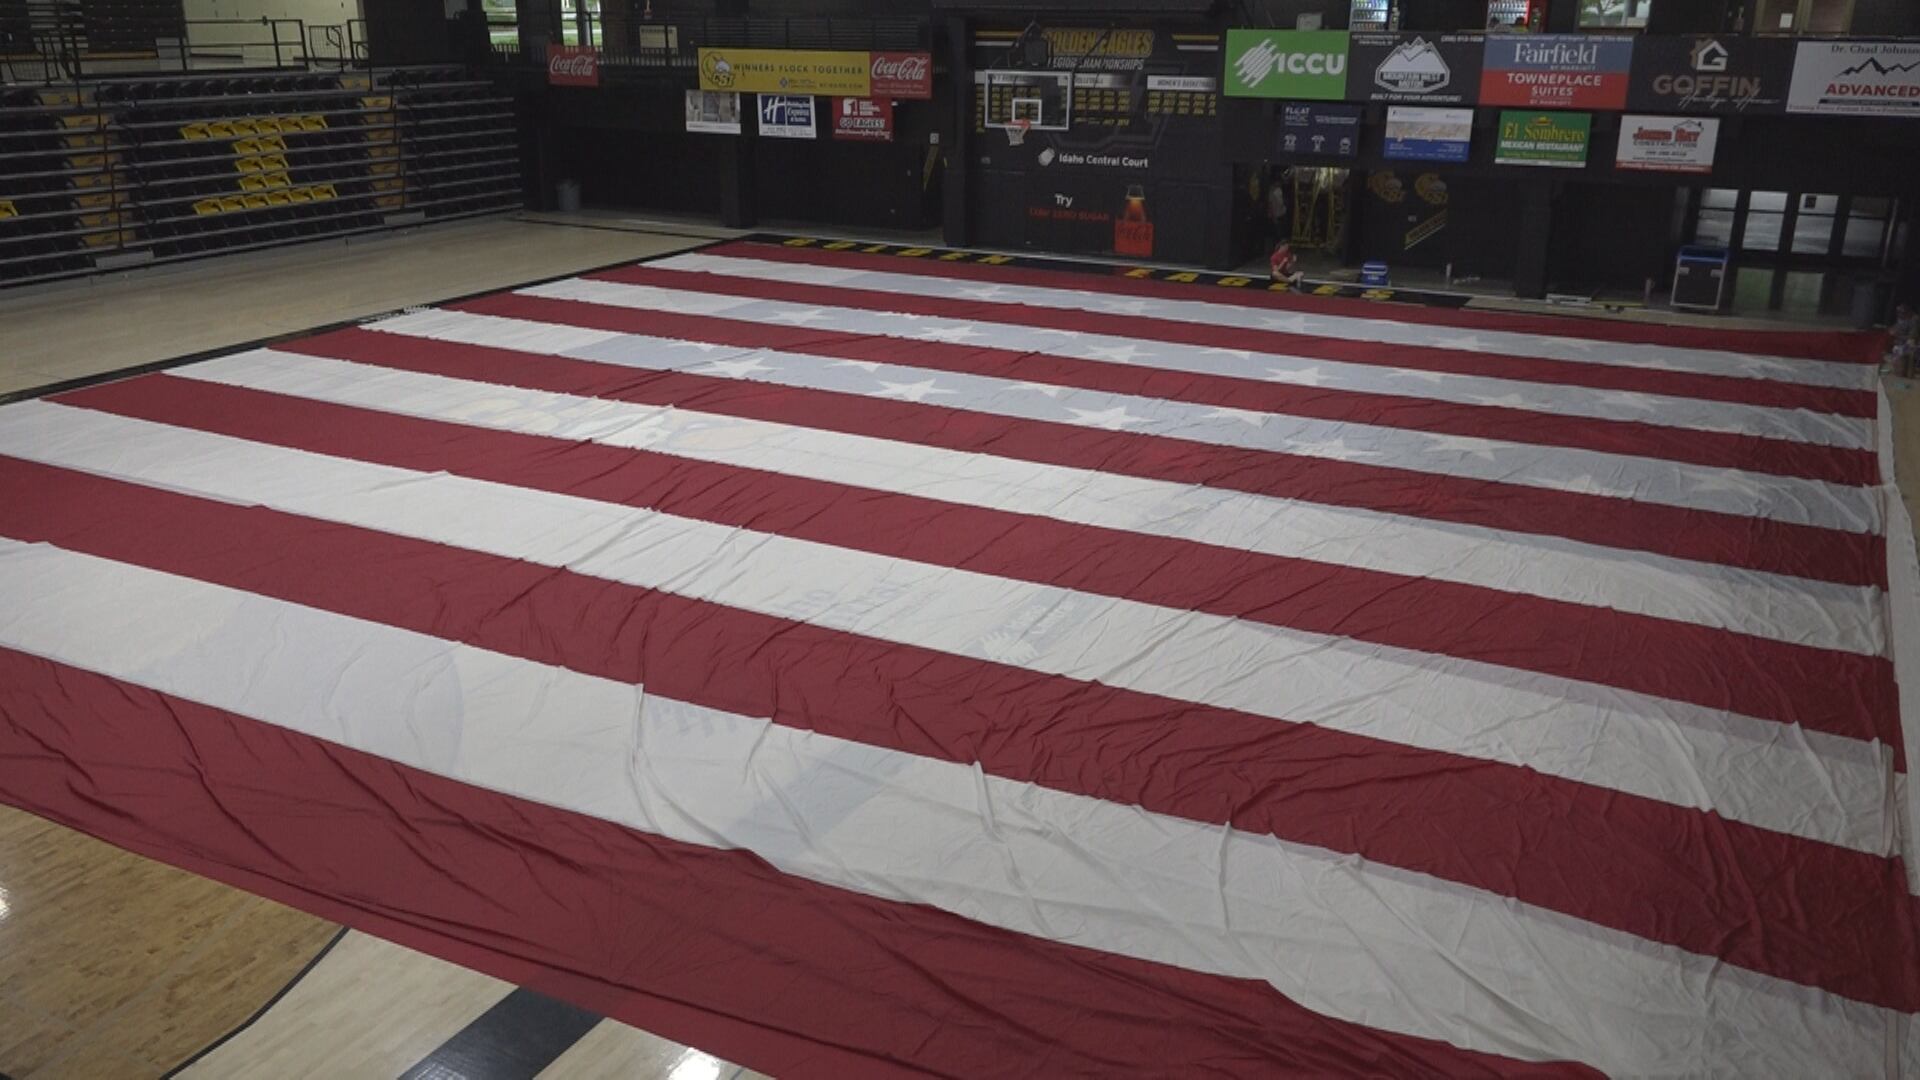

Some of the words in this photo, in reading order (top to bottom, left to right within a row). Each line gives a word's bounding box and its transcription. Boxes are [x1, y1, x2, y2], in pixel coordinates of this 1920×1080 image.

[1098, 31, 1152, 54] EAGLES
[1831, 45, 1847, 53] Dr.
[1850, 45, 1877, 54] Chad
[1514, 42, 1598, 65] Fairfield
[549, 54, 594, 76] Coca-Cola
[734, 63, 775, 73] WINNERS
[778, 65, 809, 74] FLOCK
[813, 66, 864, 75] TOGETHER
[871, 56, 929, 80] Coca-Cola
[1079, 57, 1144, 70] HAMIONSHIPS
[1277, 52, 1345, 76] ICCU
[1506, 72, 1603, 86] TOWNEPLACE
[1653, 74, 1761, 98] GOFFIN
[1531, 86, 1574, 97] SUITES
[1825, 83, 1920, 97] ADVANCED
[1504, 122, 1519, 139] El
[1524, 124, 1584, 141] Sombrero
[1501, 140, 1535, 150] MEXICAN
[1536, 142, 1584, 152] RESTAURANT
[1059, 153, 1083, 164] Idaho
[1086, 154, 1119, 165] Central
[1122, 156, 1149, 168] Court
[1054, 193, 1073, 208] Try
